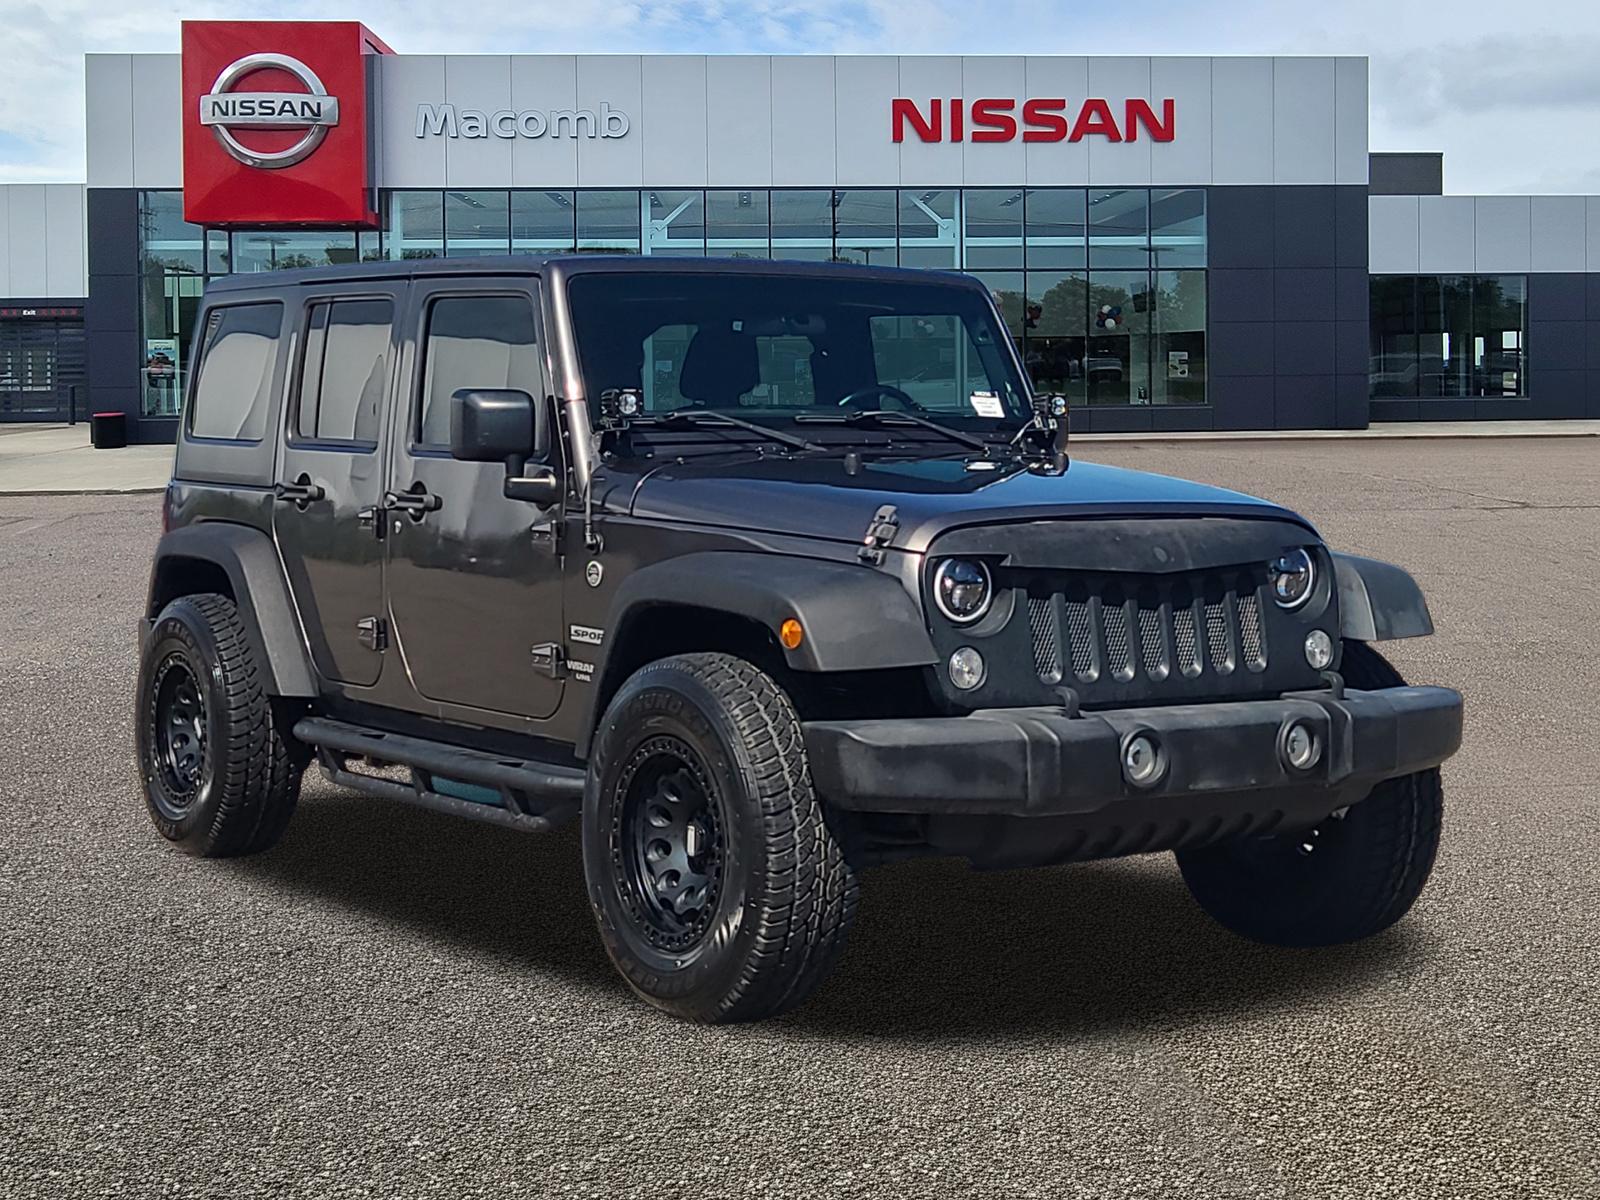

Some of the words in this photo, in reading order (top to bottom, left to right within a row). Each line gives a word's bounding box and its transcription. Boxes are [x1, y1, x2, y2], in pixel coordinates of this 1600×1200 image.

[212, 100, 322, 117] NISSAN
[415, 102, 630, 138] Macomb
[892, 98, 1175, 143] NISSAN
